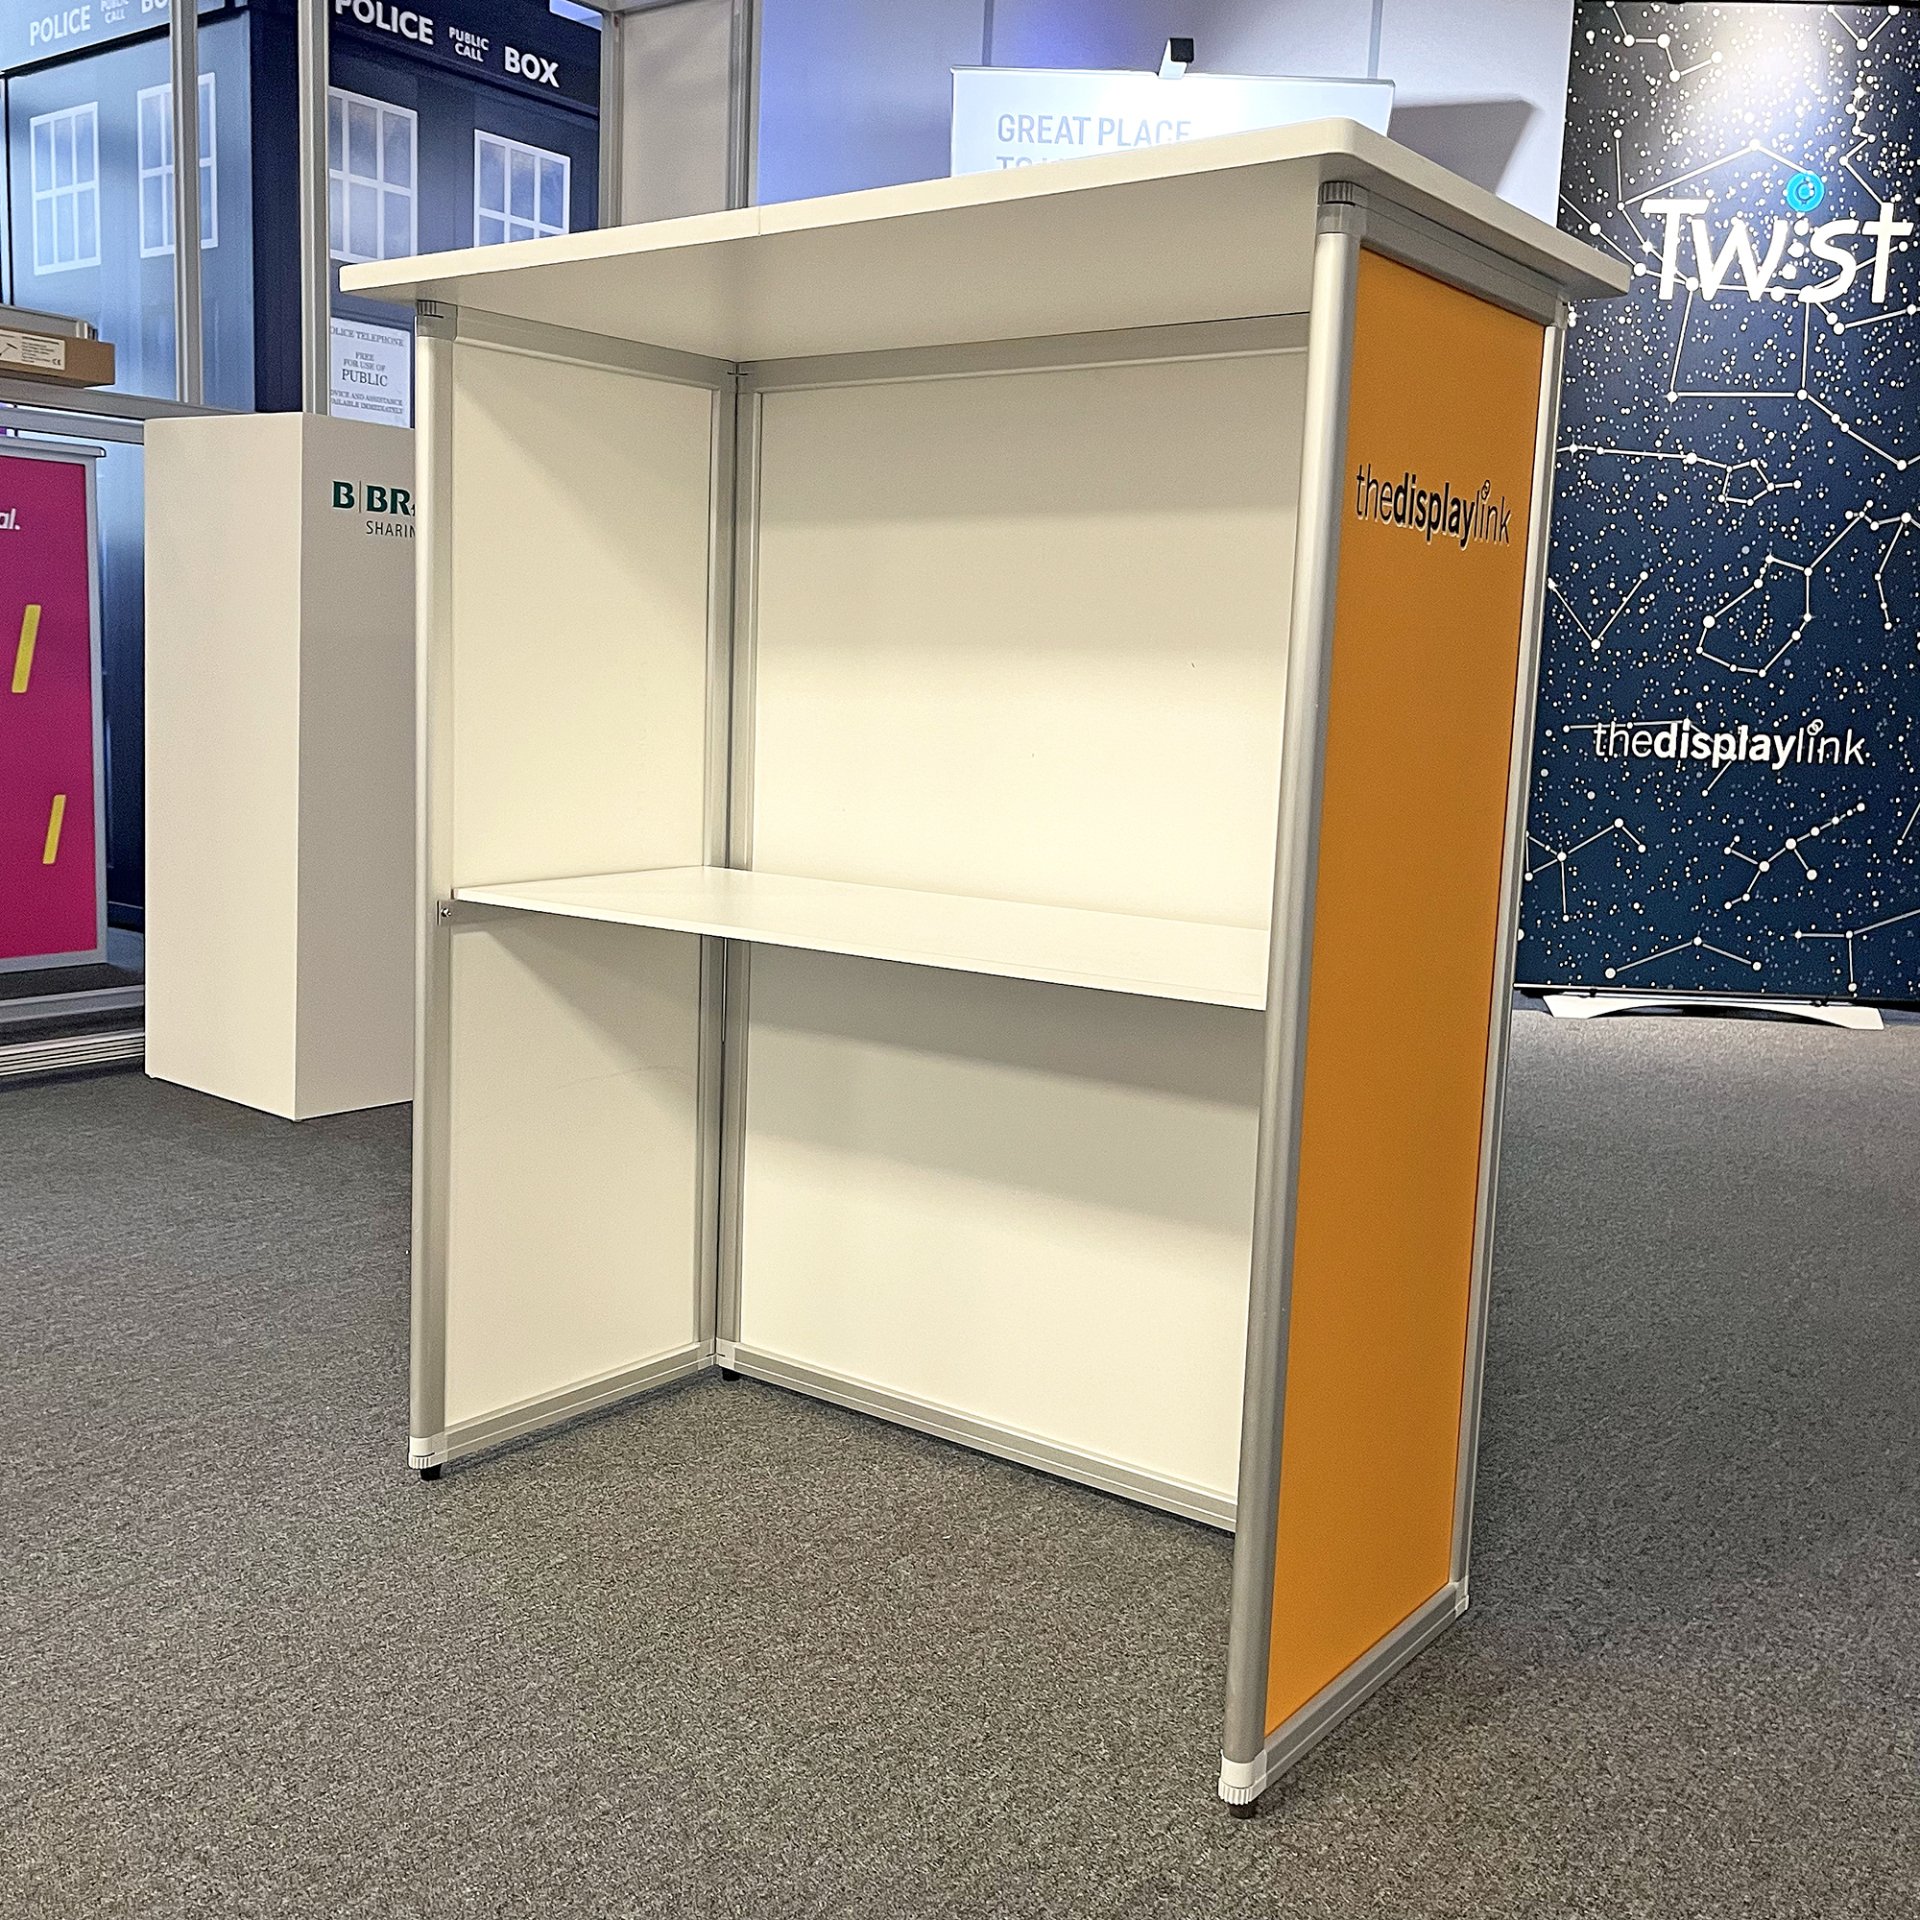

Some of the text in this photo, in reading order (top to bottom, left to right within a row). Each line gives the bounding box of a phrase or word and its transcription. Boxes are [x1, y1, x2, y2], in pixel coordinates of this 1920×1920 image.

[30, 5, 91, 47] POLICE
[105, 8, 126, 24] CALL
[335, 0, 434, 45] POLICE
[449, 27, 490, 50] PUBLIC
[455, 43, 484, 62] CALL
[505, 46, 560, 88] BOX
[998, 114, 1192, 146] GREAT PLACE
[356, 331, 404, 347] TELEPHONE
[344, 359, 386, 372] FOR USE OF
[356, 352, 374, 361] FREE
[342, 369, 388, 387] PUBLIC
[366, 485, 415, 516] BR
[1356, 463, 1512, 551] thedisplaylink
[1594, 718, 1866, 770] thedisplaylink
